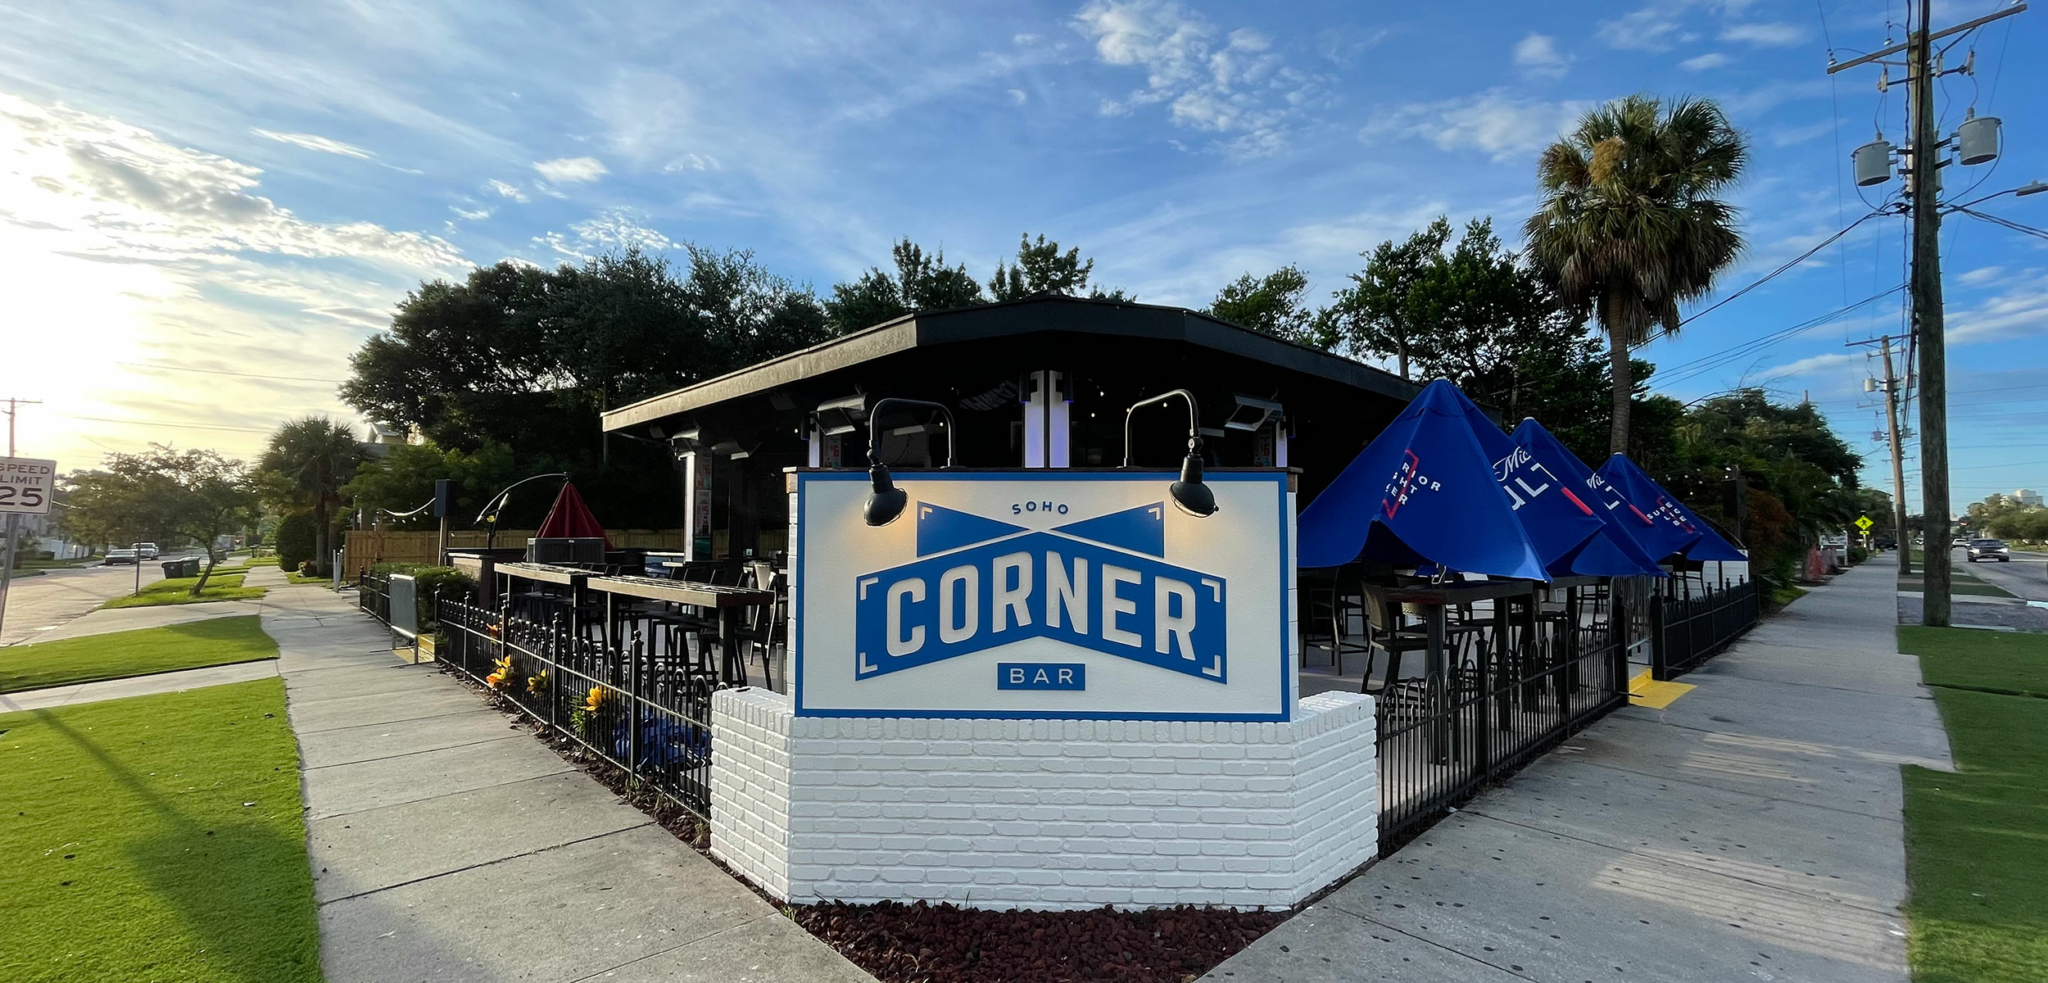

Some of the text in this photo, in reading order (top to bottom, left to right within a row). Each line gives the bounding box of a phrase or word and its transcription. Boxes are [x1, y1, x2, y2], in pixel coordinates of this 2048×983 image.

[0, 463, 50, 475] SPEED
[1402, 462, 1441, 492] RIOR
[0, 474, 43, 485] LIMIT
[0, 486, 43, 507] 25
[1012, 501, 1069, 515] SOHO
[886, 550, 1197, 661] CORNER
[1010, 668, 1074, 685] BAR
